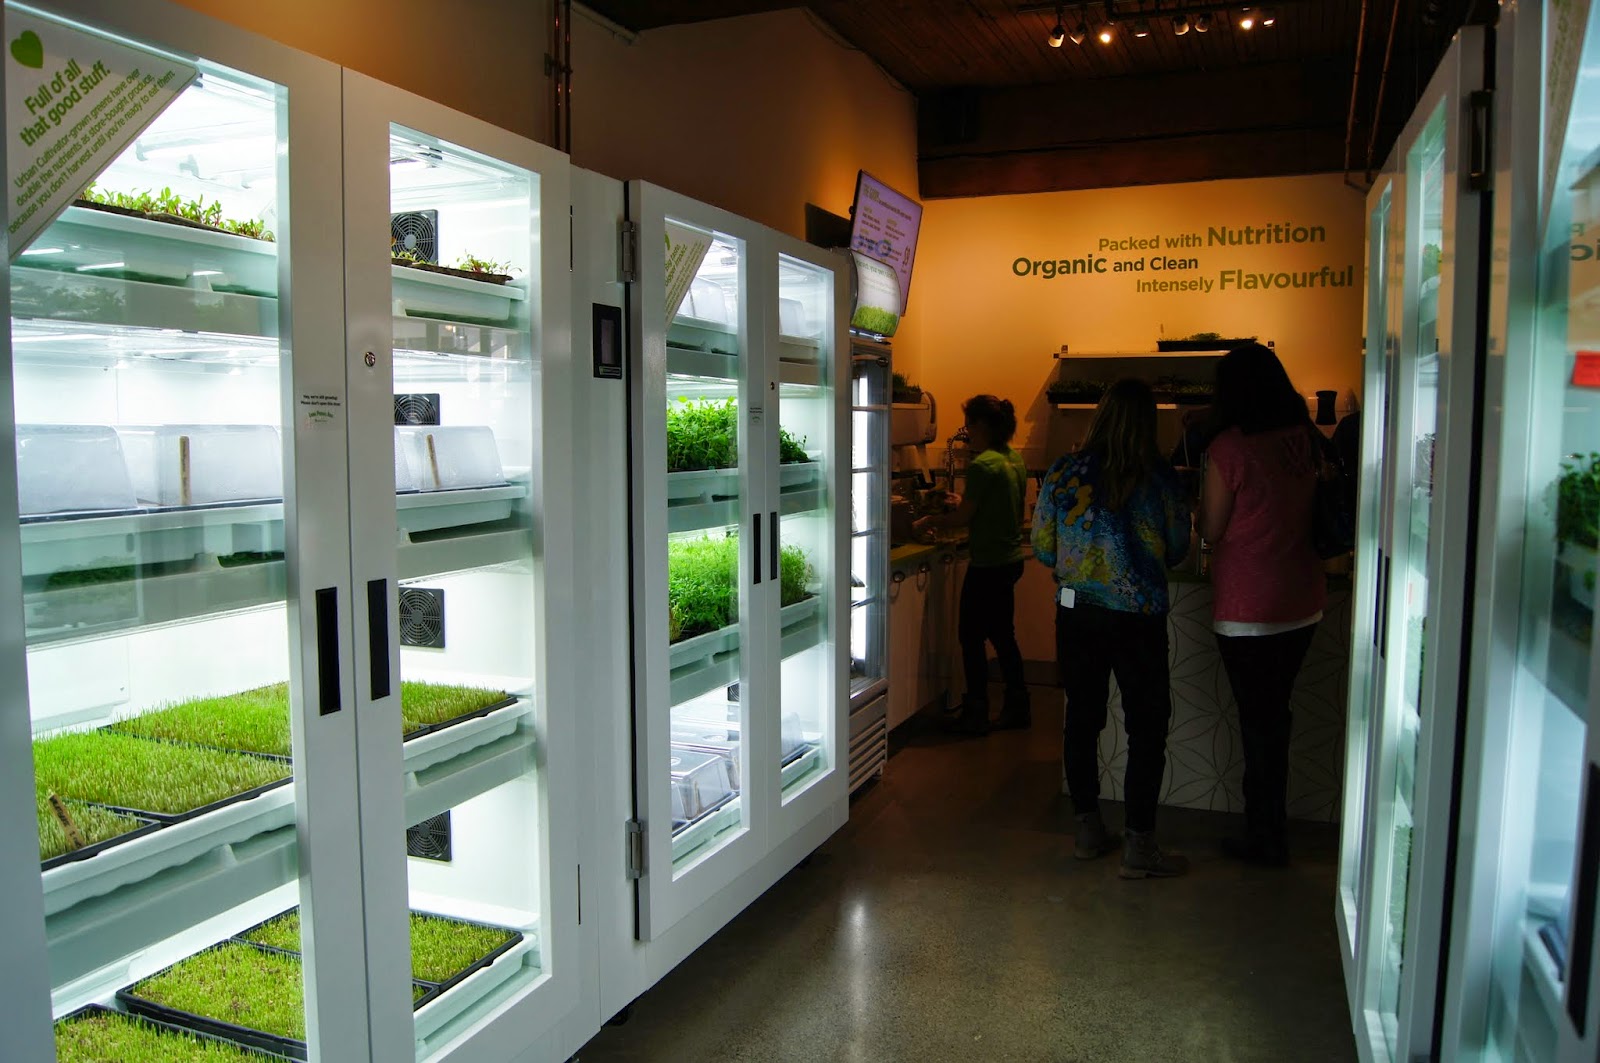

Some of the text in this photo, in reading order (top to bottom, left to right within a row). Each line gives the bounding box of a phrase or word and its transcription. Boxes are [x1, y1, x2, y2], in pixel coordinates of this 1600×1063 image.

[20, 60, 111, 147] that good stuff.
[24, 58, 82, 115] Full of all
[14, 68, 140, 188] Urban Cultivator-grown greens have over
[16, 180, 42, 207] double
[40, 169, 54, 183] the
[52, 142, 82, 172] nutrients
[81, 134, 91, 145] as
[88, 96, 129, 137] store-bought
[36, 190, 52, 208] you
[50, 171, 69, 193] don't
[67, 148, 93, 176] harvest
[91, 134, 106, 153] until
[105, 117, 126, 142] you're
[124, 101, 142, 121] ready
[141, 95, 149, 104] to
[148, 84, 159, 97] eat
[157, 70, 175, 88] them.
[1012, 254, 1199, 279] Organic and Clean
[1099, 222, 1326, 252] Packed with Nutrition
[1136, 265, 1354, 294] Intensely Flavourful
